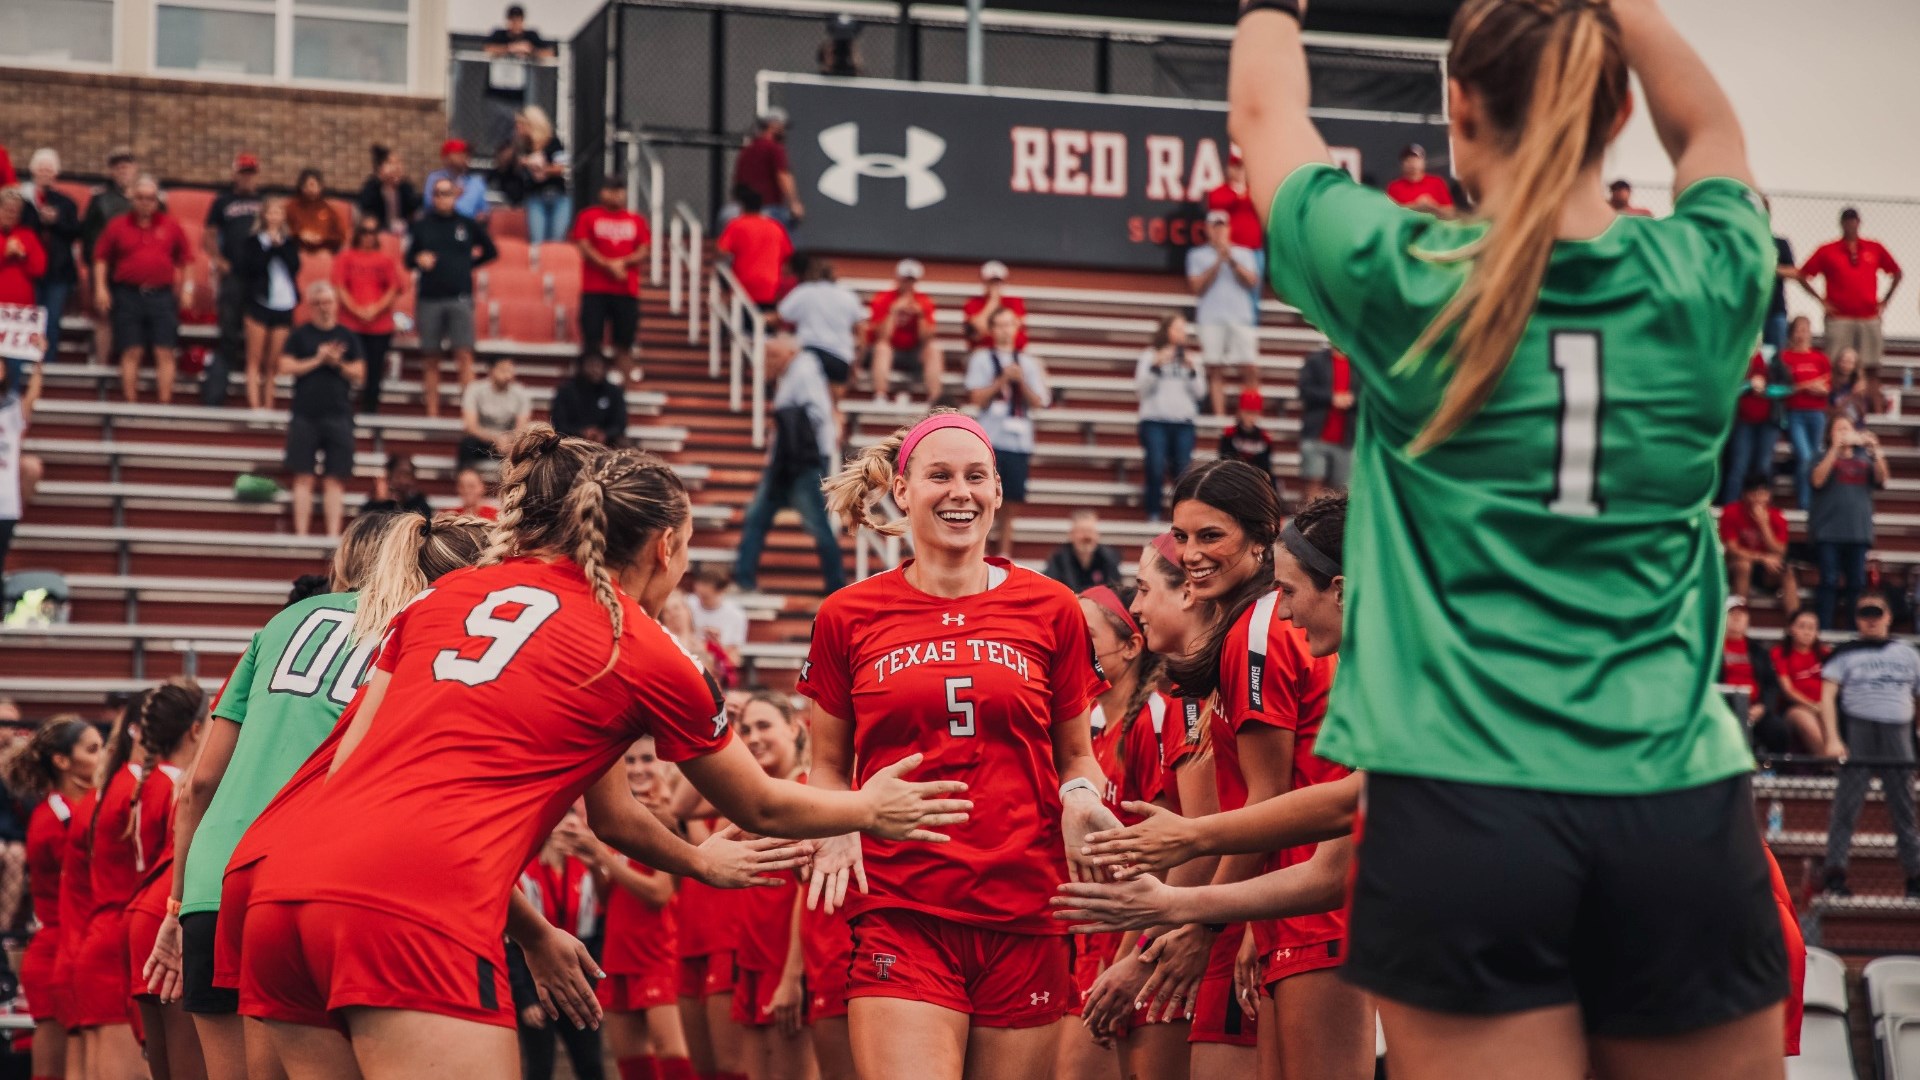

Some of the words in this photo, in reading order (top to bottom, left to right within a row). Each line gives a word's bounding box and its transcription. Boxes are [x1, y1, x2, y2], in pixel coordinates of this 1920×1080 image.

[1010, 126, 1128, 198] RED
[1128, 215, 1207, 246] SOCC
[1546, 330, 1606, 517] 1
[431, 584, 562, 687] 9
[873, 640, 957, 684] TEXAS
[965, 638, 1030, 682] TECH
[1251, 666, 1261, 691] GUNS
[1252, 692, 1261, 705] UP
[944, 676, 976, 737] 5
